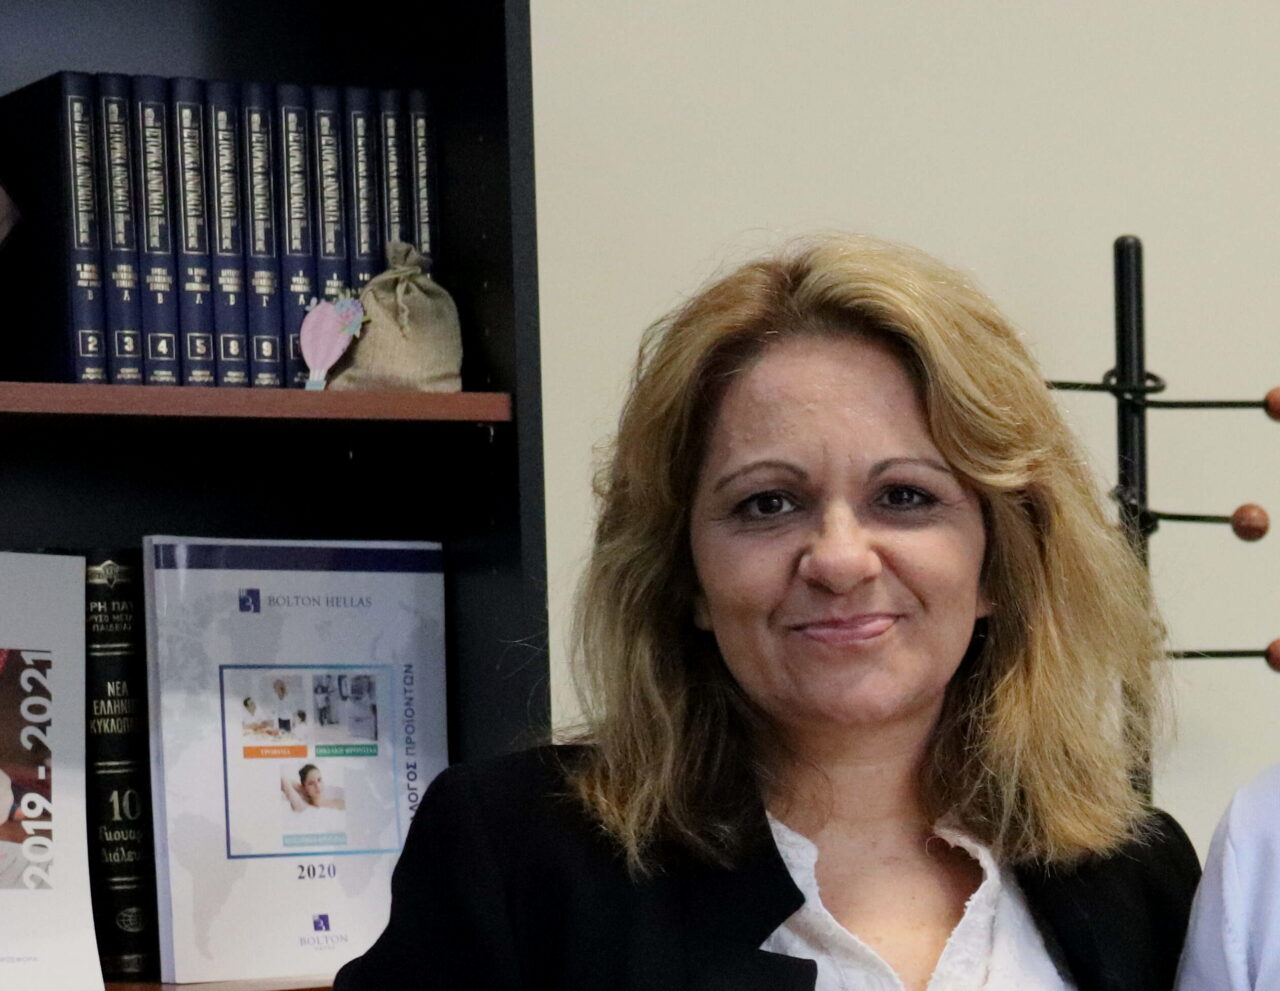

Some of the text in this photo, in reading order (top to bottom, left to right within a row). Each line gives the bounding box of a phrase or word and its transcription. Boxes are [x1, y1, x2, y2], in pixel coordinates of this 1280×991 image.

[88, 336, 98, 352] 2
[123, 336, 134, 352] 3
[157, 339, 168, 355] 4
[196, 339, 207, 355] 5
[229, 340, 239, 356] 8
[262, 341, 273, 357] 9
[268, 596, 372, 608] BOLTON HELLAS
[107, 681, 129, 697] ΝΕΑ
[20, 650, 51, 750] 2021
[109, 789, 142, 821] 10
[20, 792, 52, 889] 2019
[297, 863, 337, 880] 2020
[298, 935, 348, 947] BOLTON
